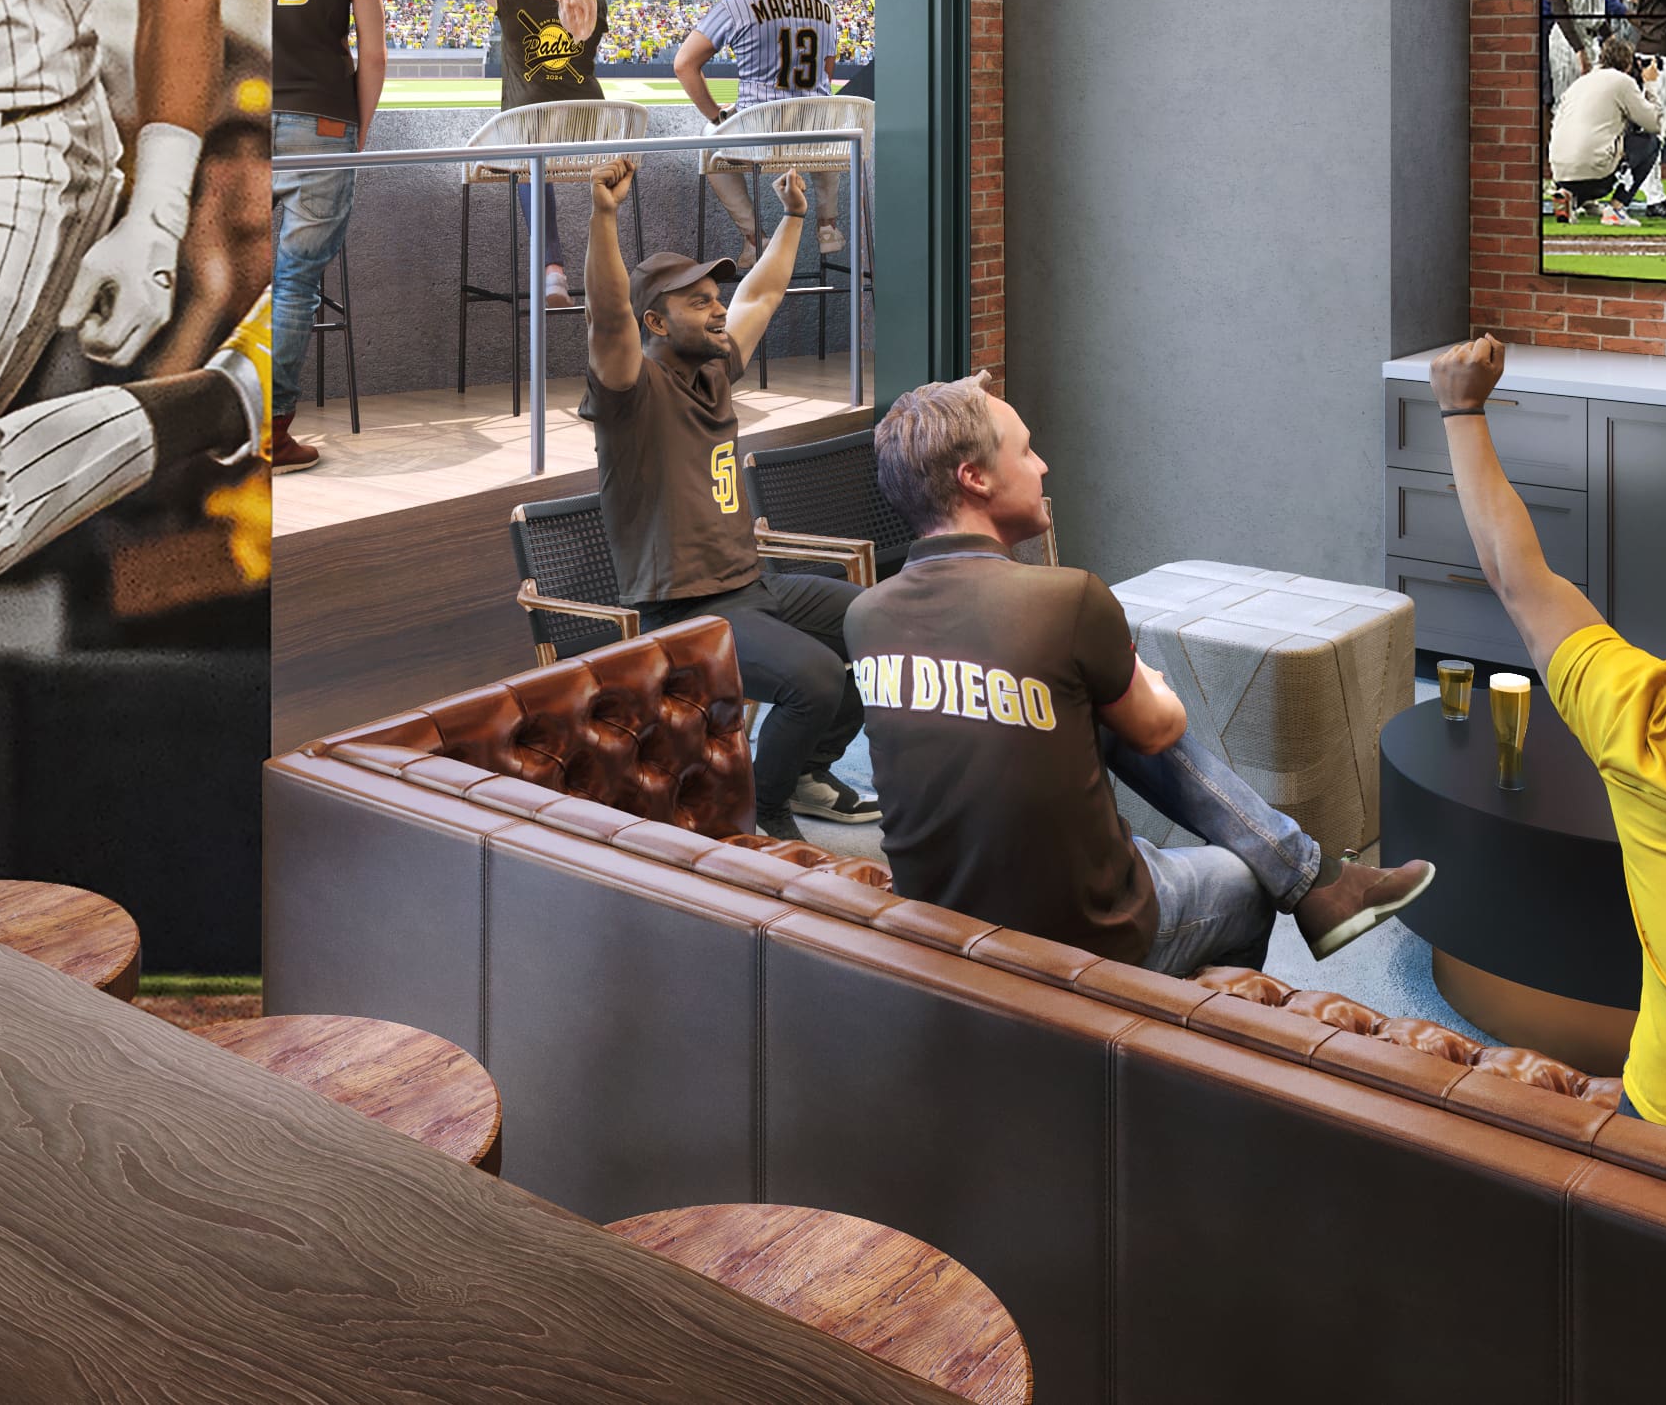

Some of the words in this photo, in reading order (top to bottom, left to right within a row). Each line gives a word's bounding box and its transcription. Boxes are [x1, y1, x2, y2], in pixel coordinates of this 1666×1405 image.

[775, 26, 818, 90] 13
[711, 440, 739, 514] SD
[910, 655, 1057, 731] DIEGO
